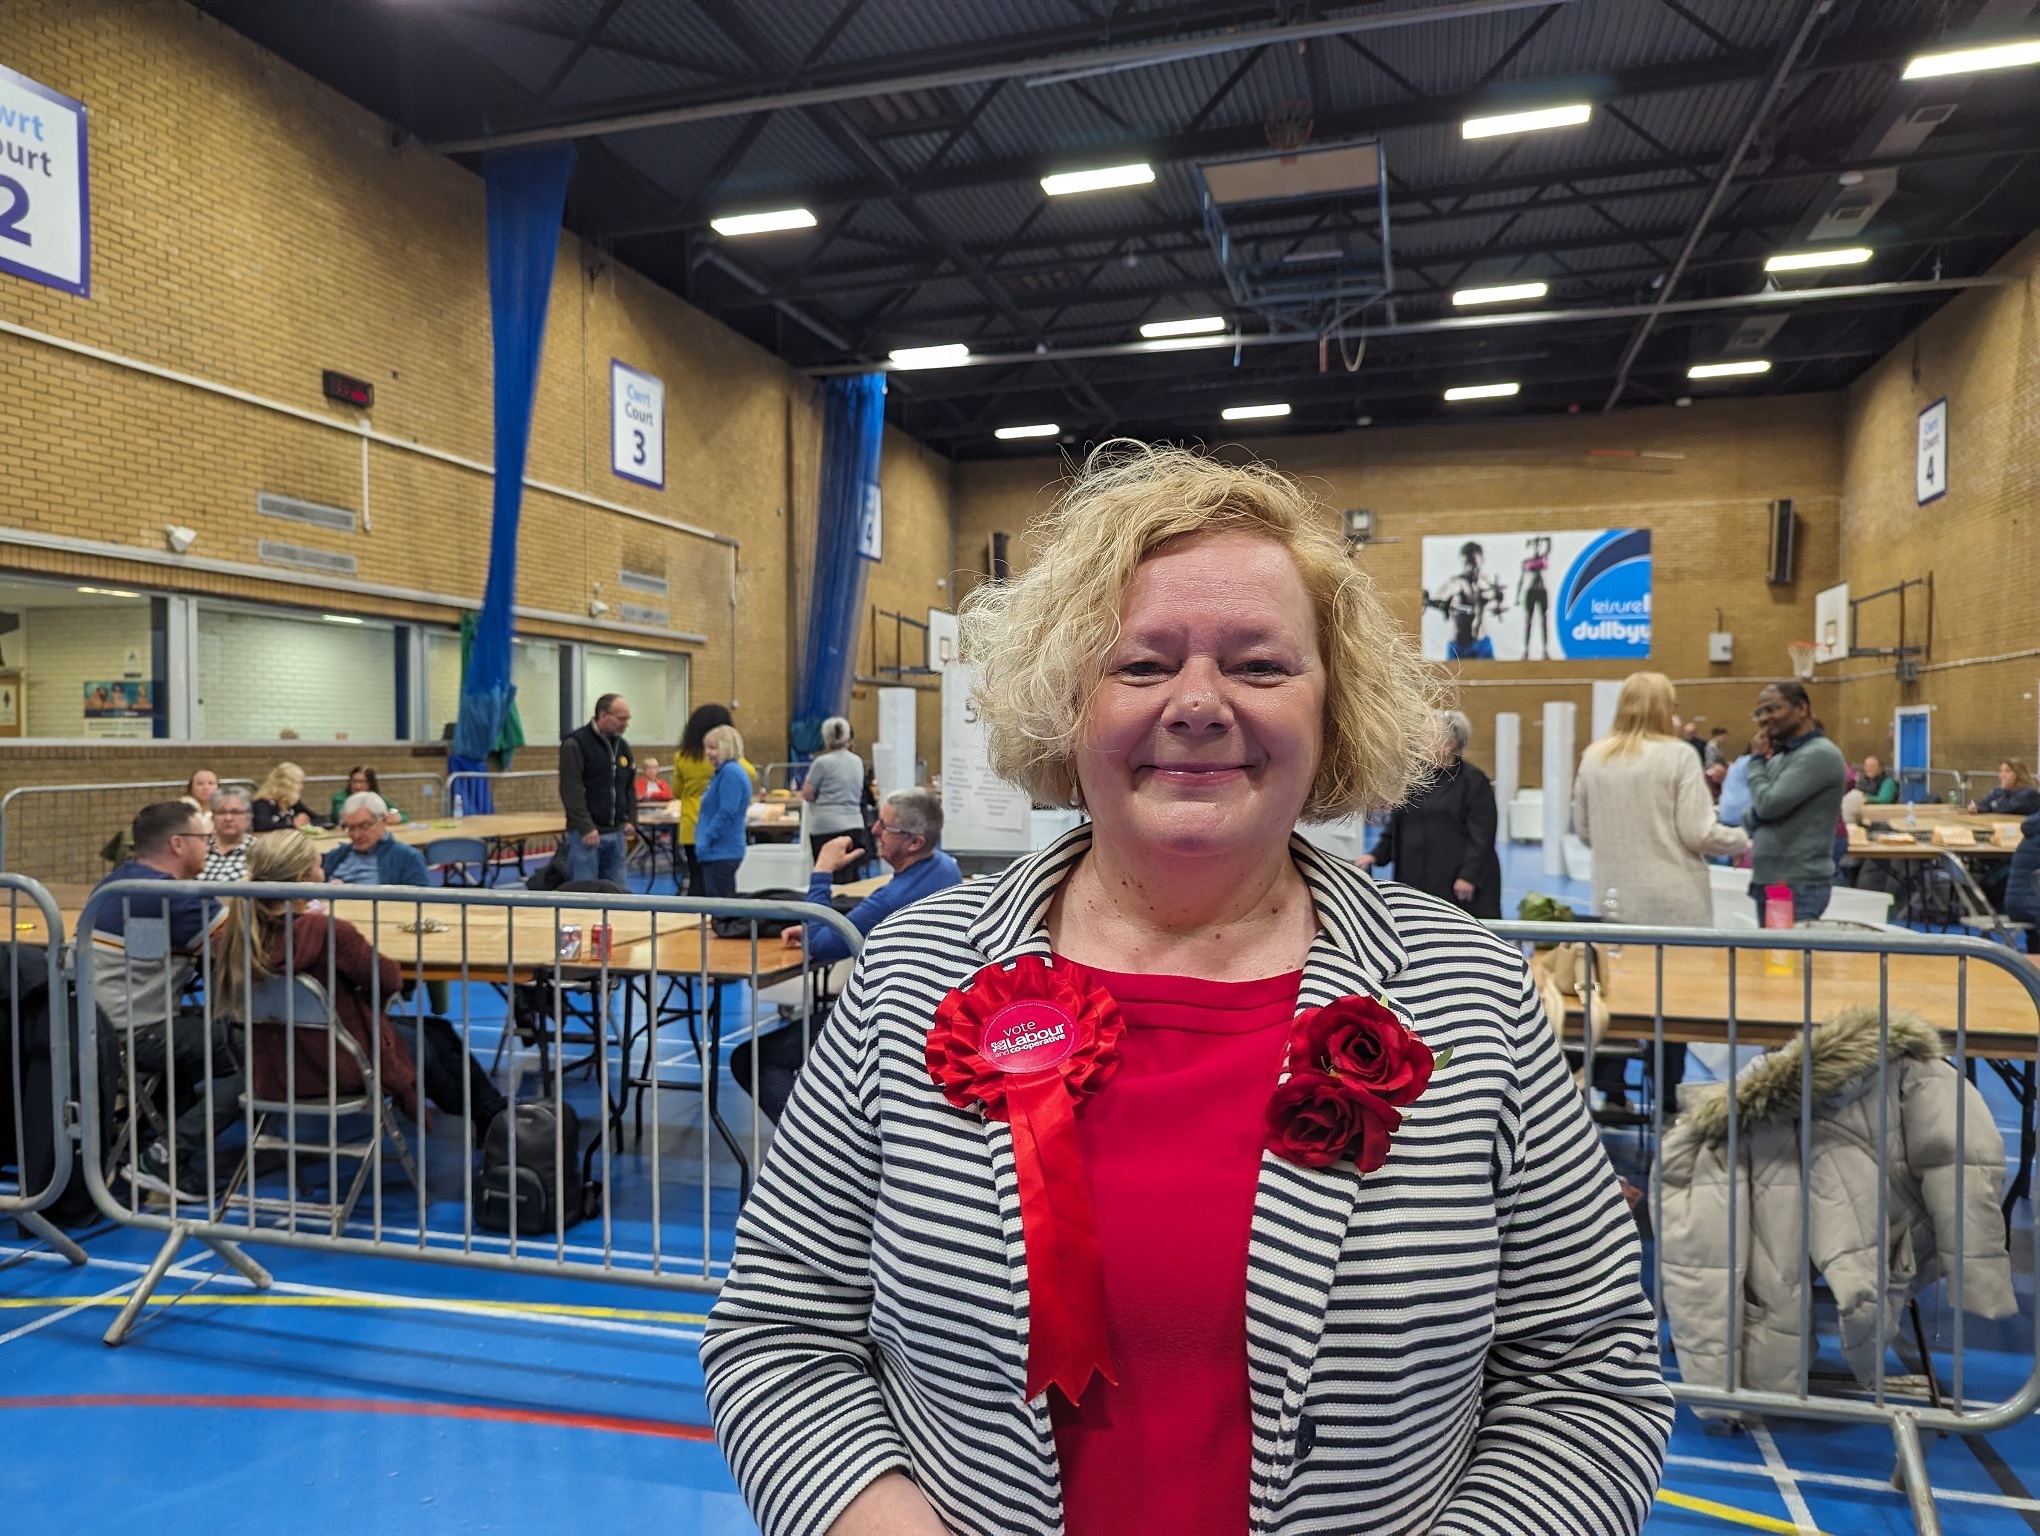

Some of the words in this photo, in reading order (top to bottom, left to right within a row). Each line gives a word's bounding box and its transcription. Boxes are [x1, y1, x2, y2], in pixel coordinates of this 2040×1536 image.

[0, 173, 33, 247] 2
[624, 402, 654, 427] Court
[633, 429, 646, 466] 3
[1926, 454, 1935, 485] 4
[1003, 1021, 1037, 1037] vote
[1006, 1023, 1065, 1048] Labour
[1010, 1033, 1066, 1054] co-operative
